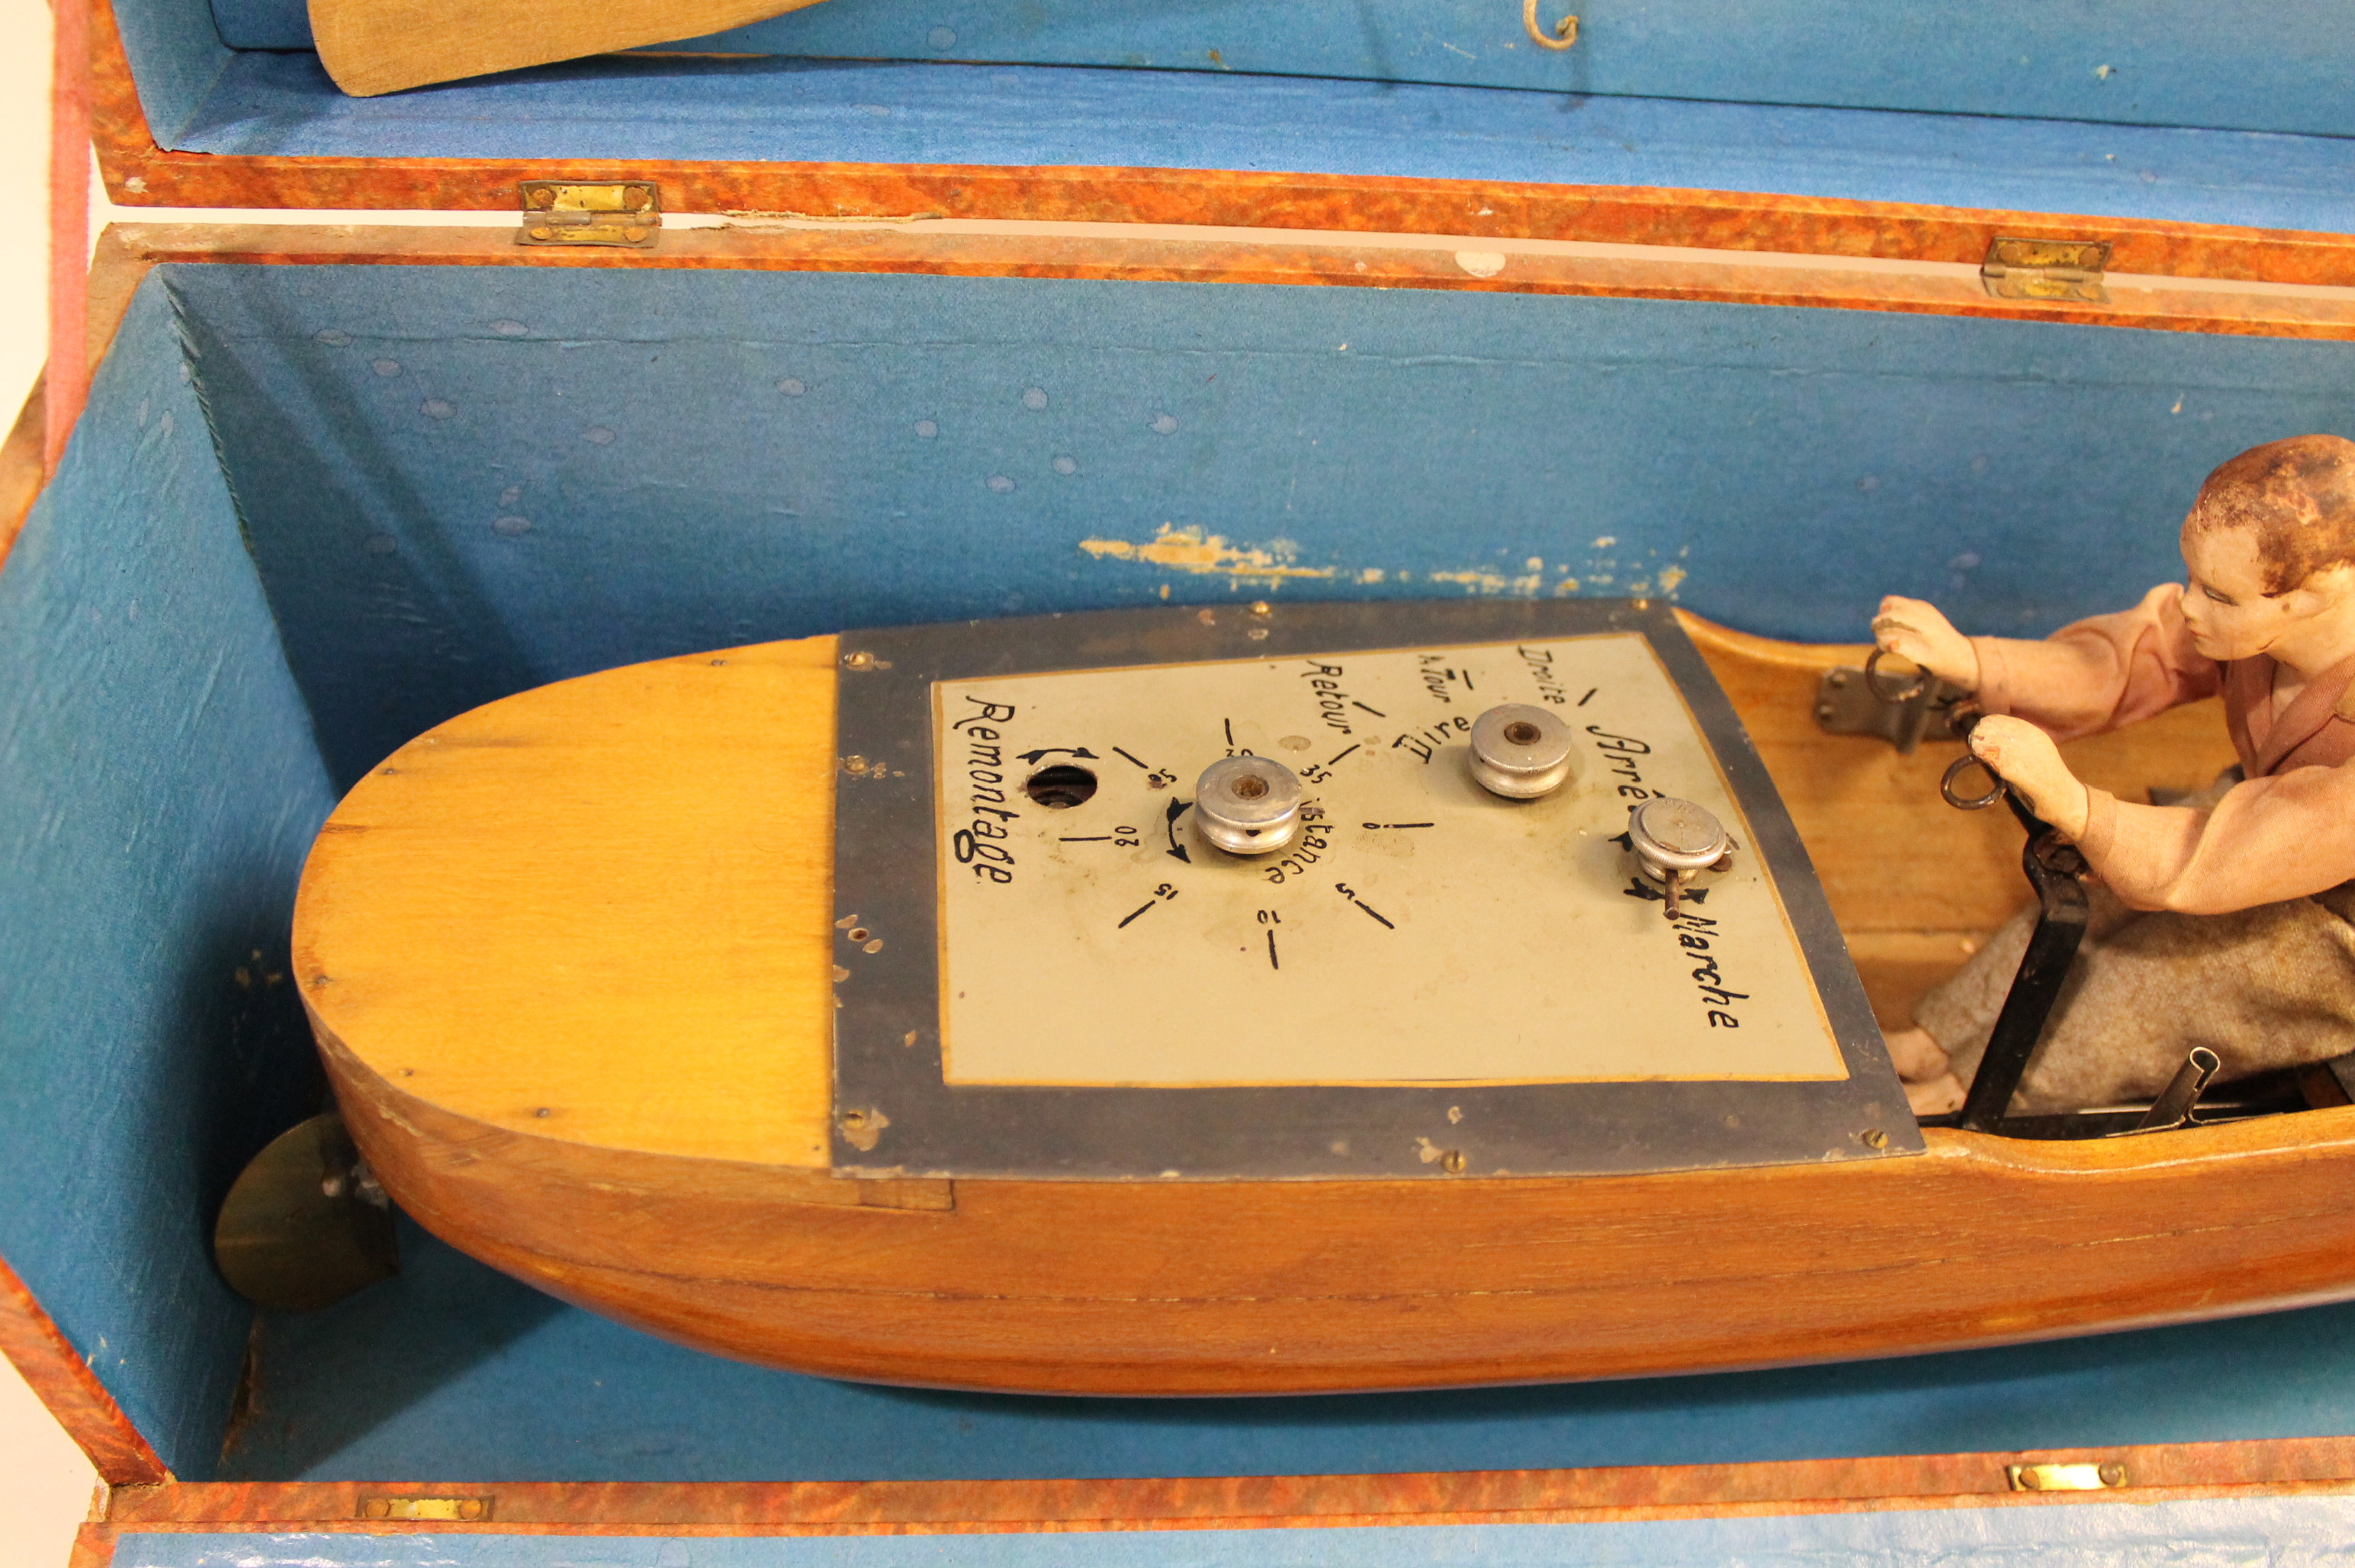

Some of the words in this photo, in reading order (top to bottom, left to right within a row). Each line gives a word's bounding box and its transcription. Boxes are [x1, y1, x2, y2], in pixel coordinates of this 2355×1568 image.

[1300, 660, 1352, 735] Retour
[1518, 645, 1566, 704] Droite
[953, 695, 1020, 884] Remontage
[1300, 764, 1332, 784] 35
[1586, 725, 1666, 813] Arrê
[1114, 825, 1139, 847] 20
[1262, 797, 1335, 885] istance
[1154, 882, 1179, 900] 15
[1257, 909, 1282, 924] 10
[1335, 882, 1356, 901] 5
[1672, 913, 1749, 1028] Marche
